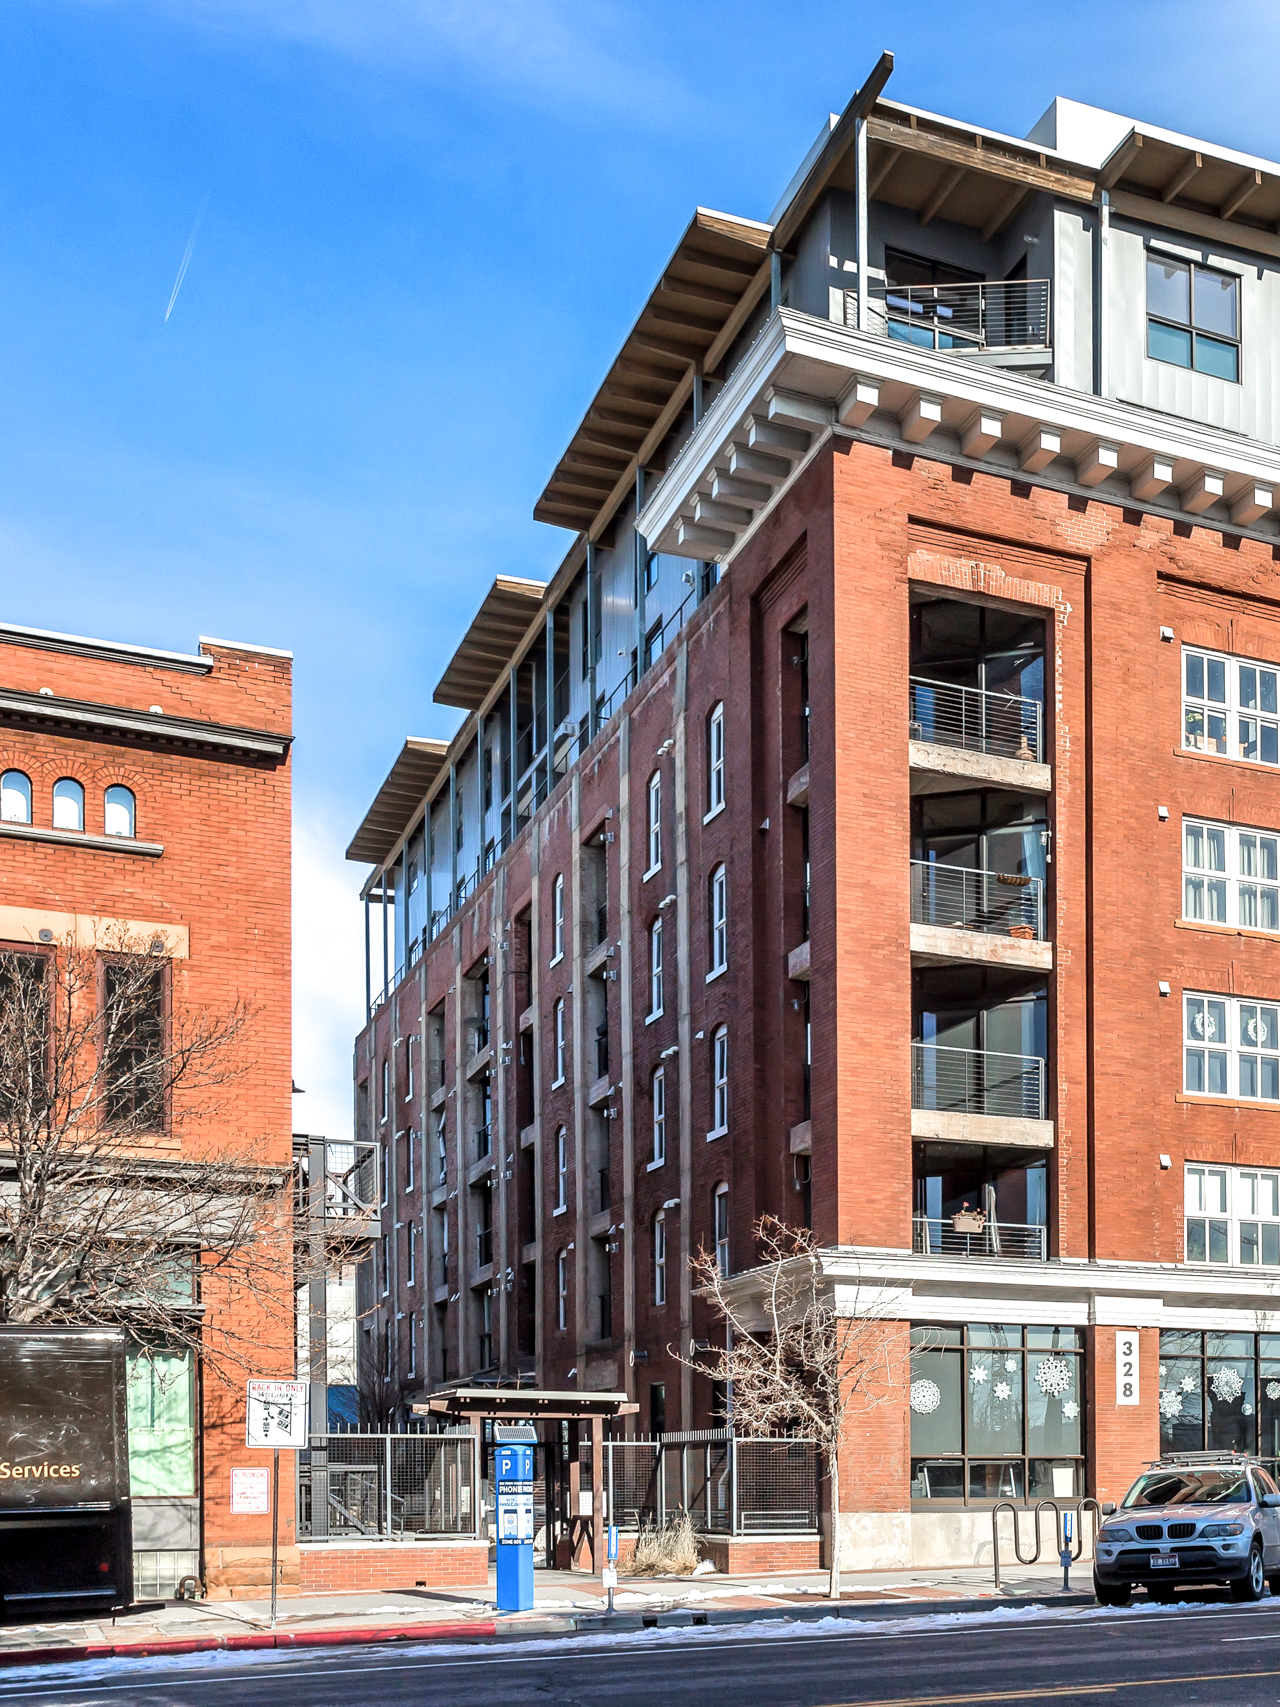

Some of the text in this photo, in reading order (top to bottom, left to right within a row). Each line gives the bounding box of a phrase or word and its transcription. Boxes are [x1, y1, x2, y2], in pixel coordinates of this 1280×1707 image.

[251, 1383, 304, 1392] BACK IN ONLY
[0, 1461, 81, 1479] Services
[502, 1459, 512, 1475] P
[499, 1485, 523, 1493] PHONE
